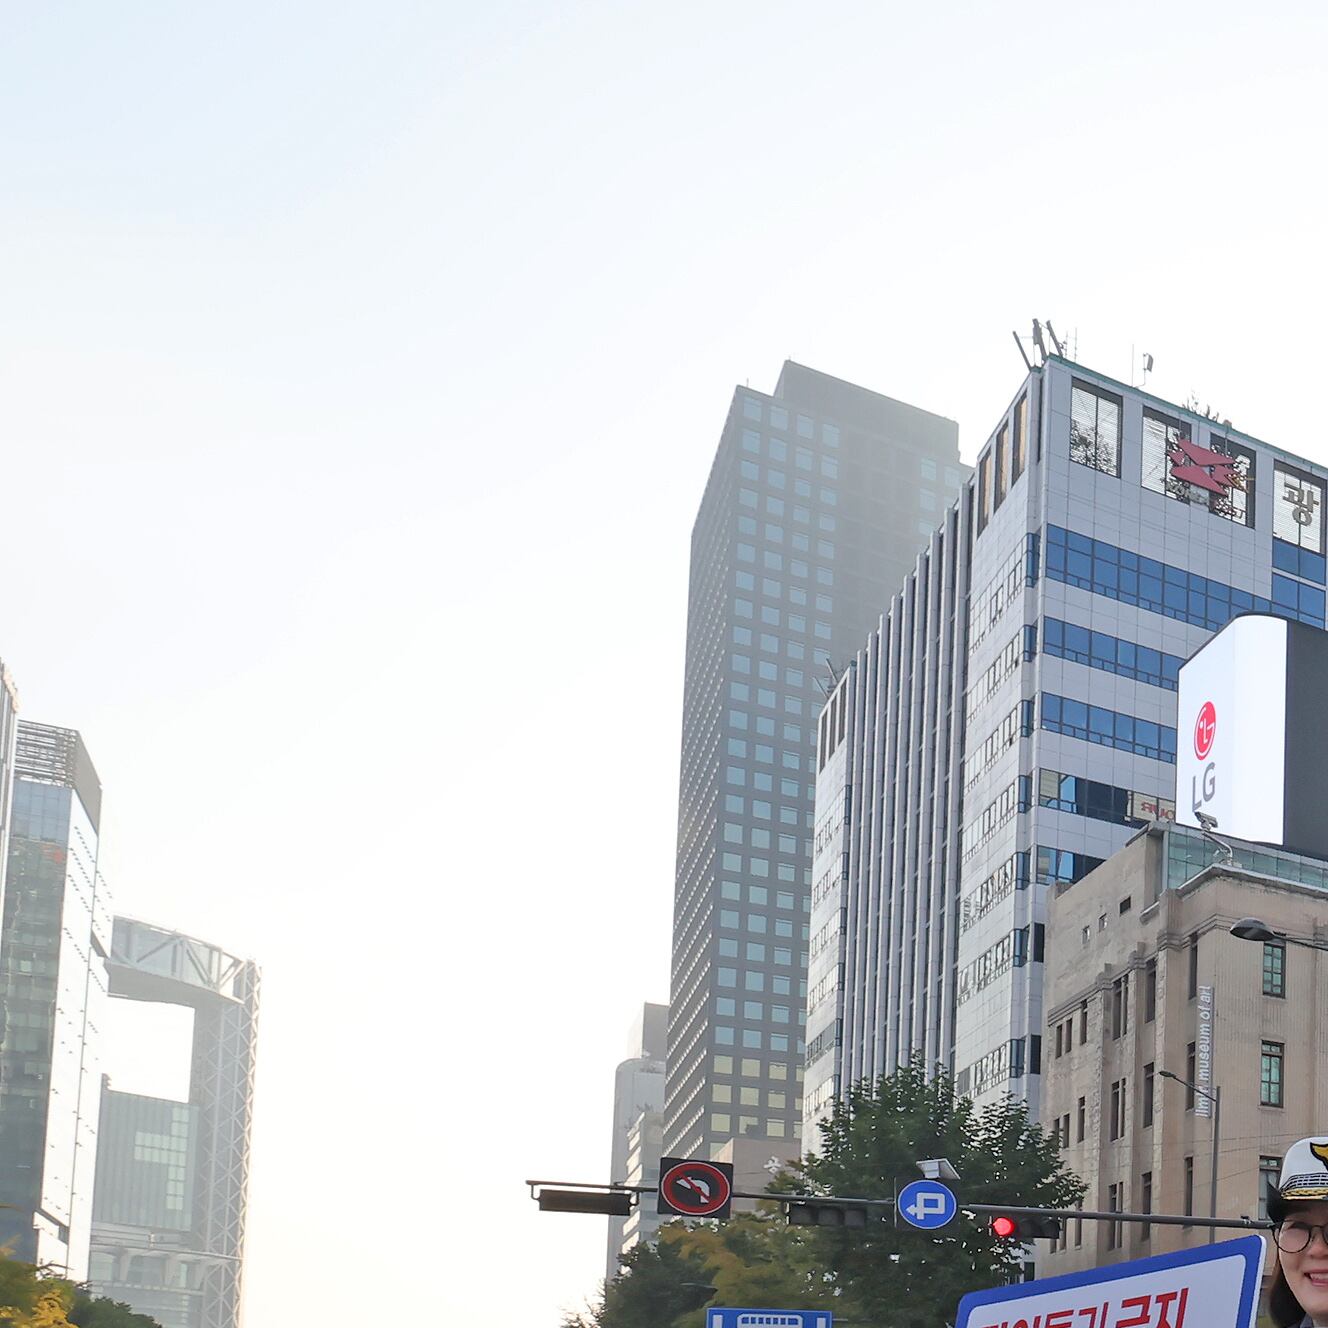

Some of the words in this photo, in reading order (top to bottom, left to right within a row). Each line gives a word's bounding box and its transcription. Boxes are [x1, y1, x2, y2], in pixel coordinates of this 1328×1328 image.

[1192, 761, 1216, 813] LG
[1199, 985, 1212, 1002] art
[1198, 1005, 1211, 1020] of
[1199, 1024, 1211, 1082] museum
